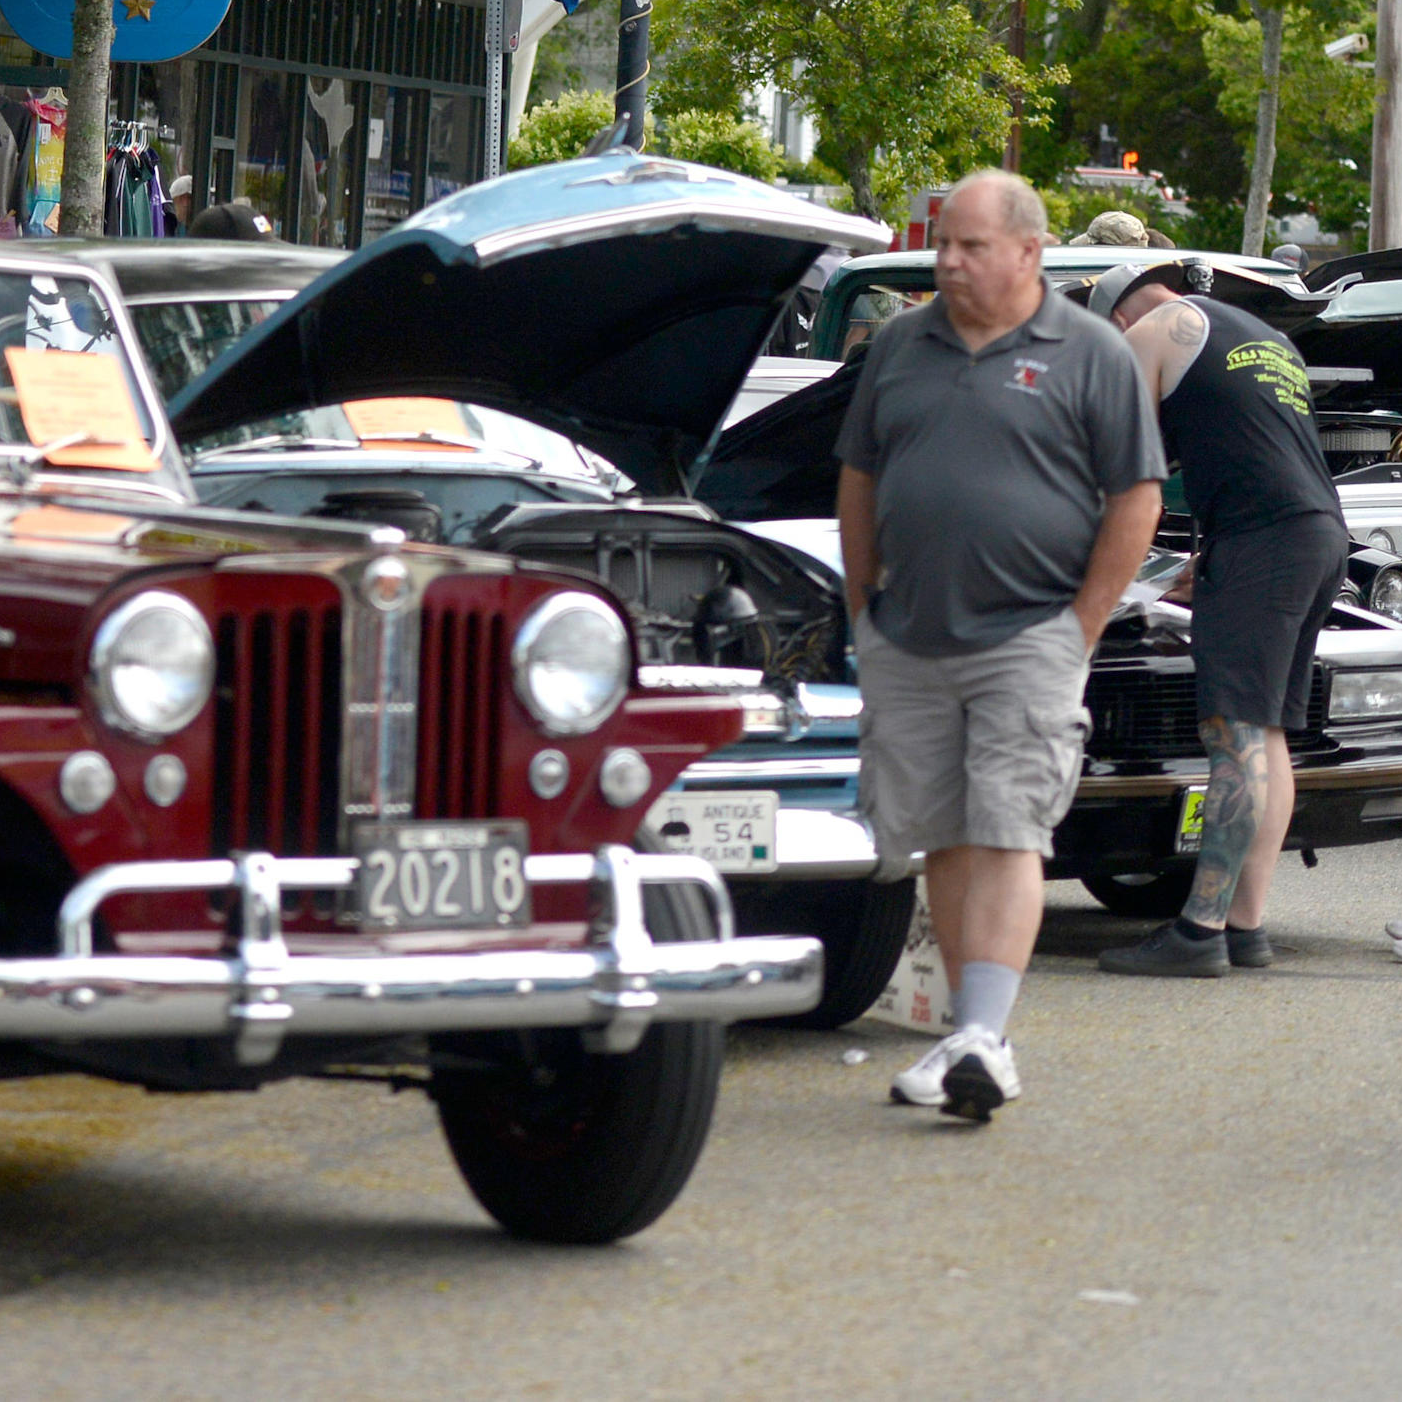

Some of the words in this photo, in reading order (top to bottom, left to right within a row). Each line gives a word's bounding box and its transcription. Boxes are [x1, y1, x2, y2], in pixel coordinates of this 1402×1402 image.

[702, 804, 765, 819] ANTIQUE
[714, 822, 753, 843] 54
[367, 846, 526, 917] 20218
